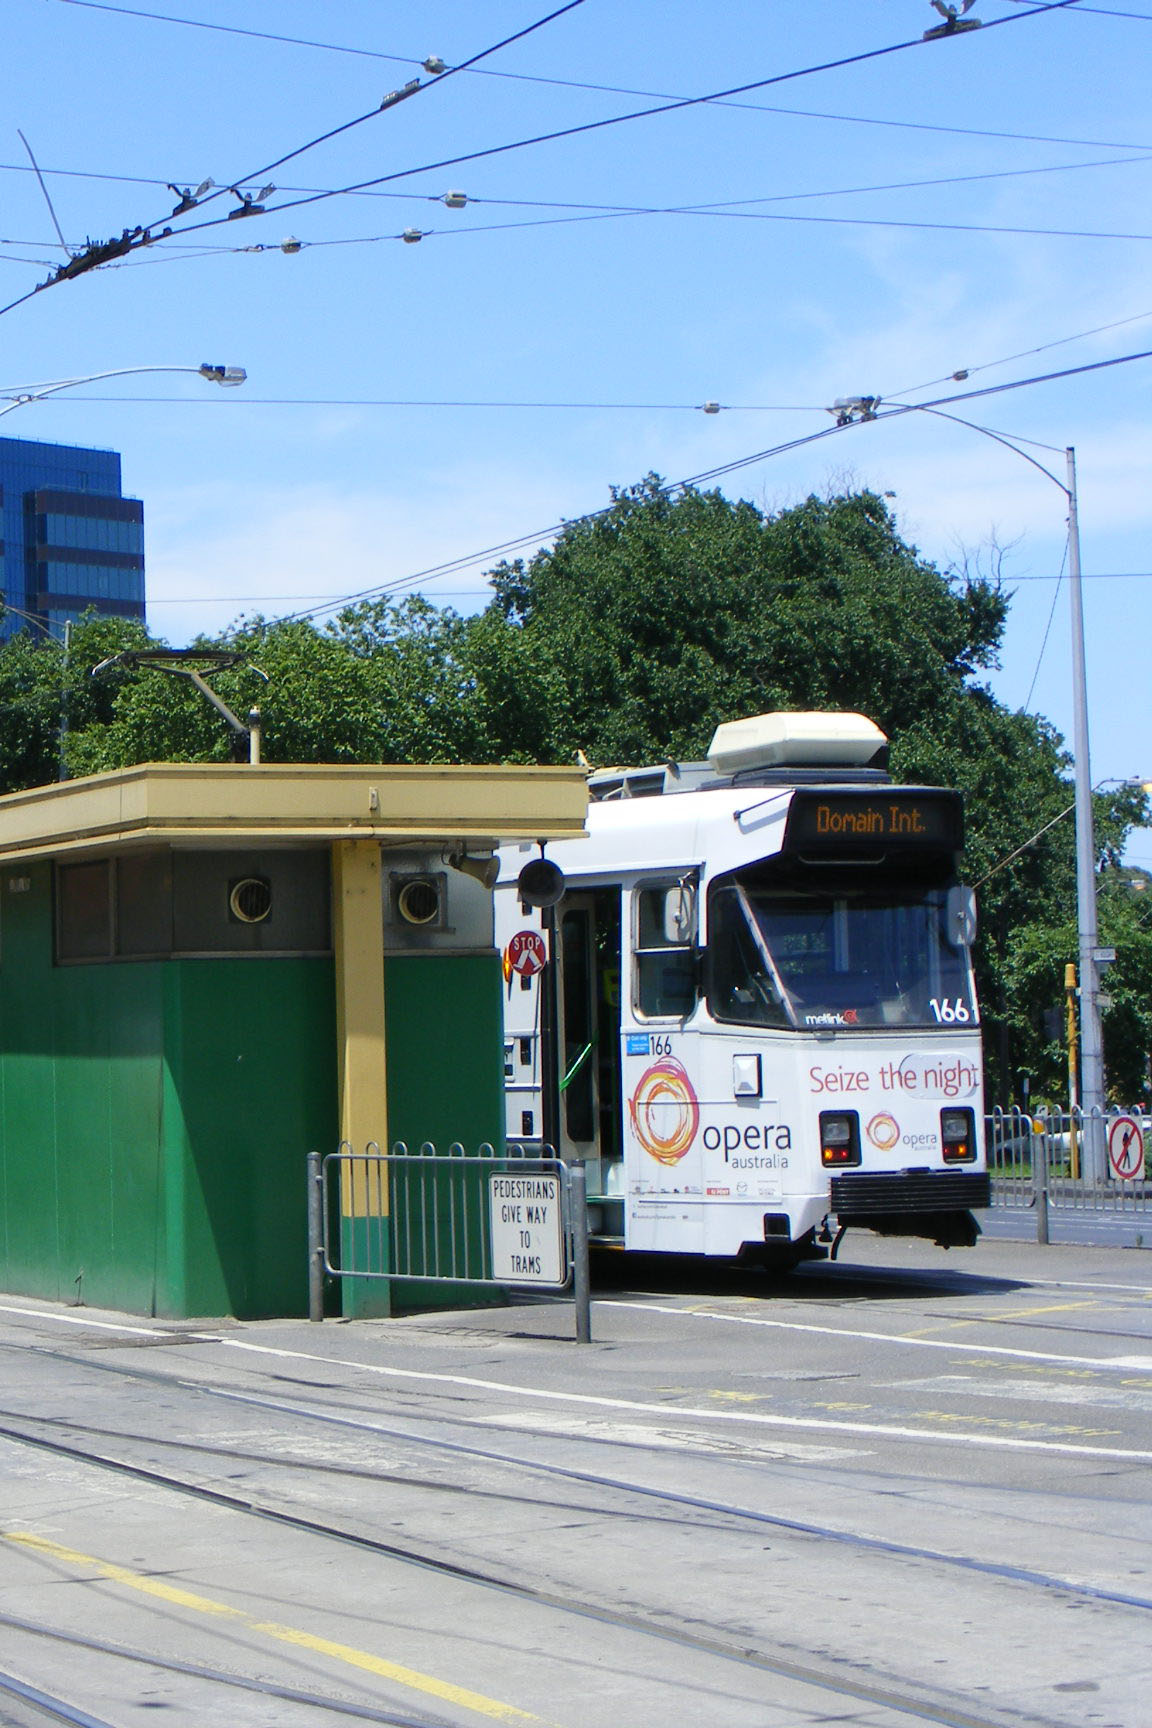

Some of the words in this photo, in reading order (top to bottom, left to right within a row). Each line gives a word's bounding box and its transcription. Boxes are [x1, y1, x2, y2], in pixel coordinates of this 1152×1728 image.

[816, 805, 884, 833] Domain
[889, 805, 927, 833] Int.
[513, 936, 541, 951] STOP
[805, 1011, 844, 1025] metlink
[930, 998, 969, 1023] 166
[650, 1035, 672, 1056] 166
[809, 1065, 869, 1094] Seize
[879, 1062, 917, 1090] the
[924, 1059, 980, 1097] night
[703, 1125, 792, 1163] opera
[902, 1134, 937, 1149] opera
[731, 1153, 789, 1169] australia
[493, 1180, 555, 1200] PEDESTRIANS
[501, 1205, 521, 1223] GIVE
[526, 1206, 547, 1224] WAY
[519, 1230, 531, 1249] TO
[510, 1255, 541, 1274] TRAMS
